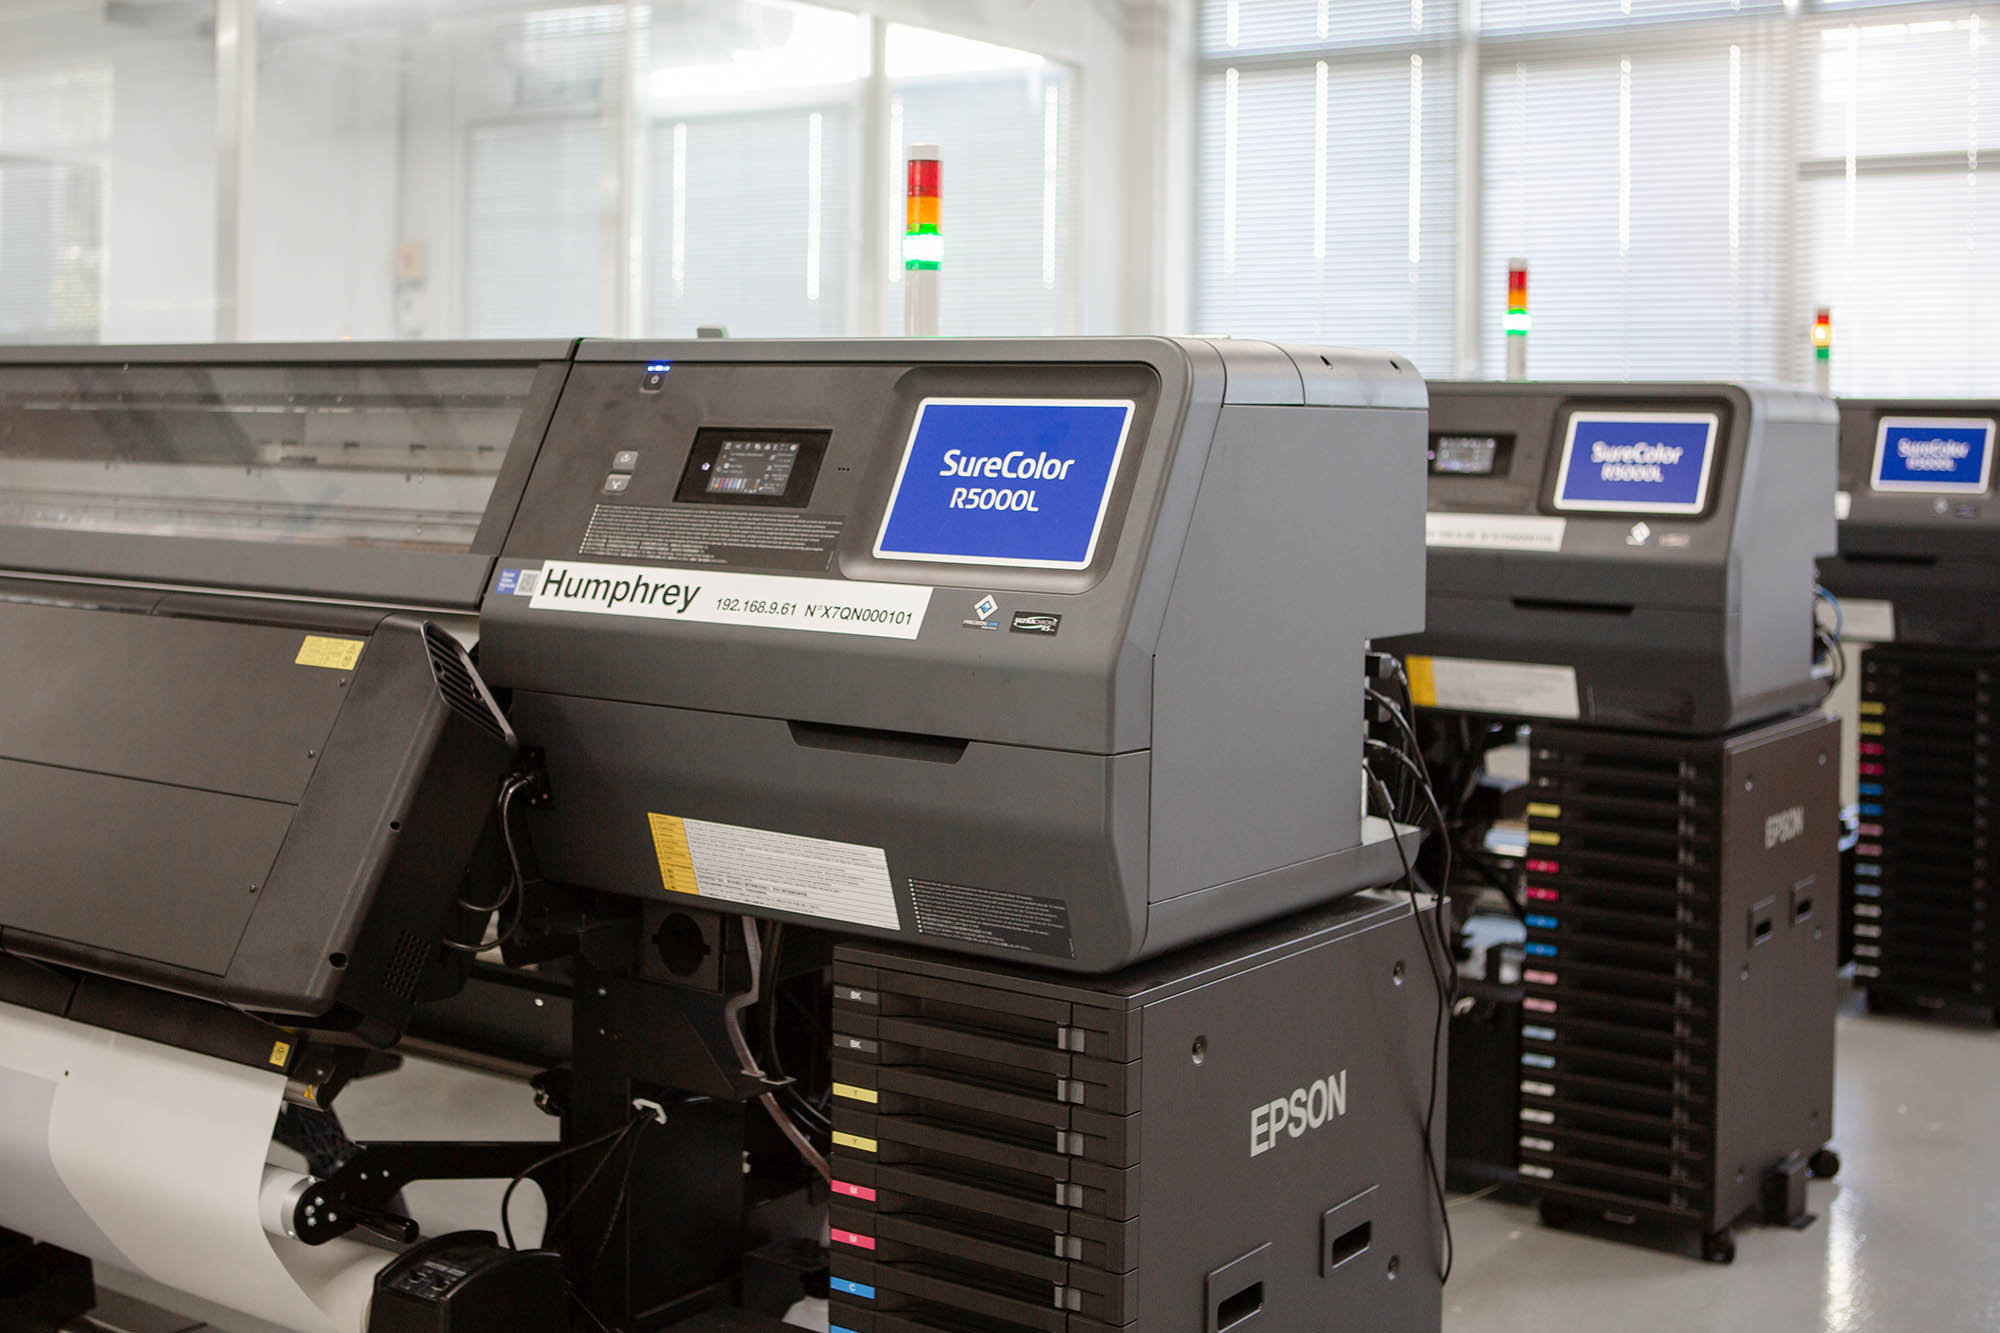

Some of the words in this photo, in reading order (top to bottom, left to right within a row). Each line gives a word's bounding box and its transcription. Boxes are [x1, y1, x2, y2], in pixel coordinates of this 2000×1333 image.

[939, 449, 1076, 480] SureColor
[1591, 441, 1683, 464] SureColor
[949, 487, 1039, 512] R5000L
[540, 568, 702, 614] Humphrey
[716, 598, 798, 617] 192.168.9.61
[1764, 808, 1805, 849] EPSON
[1250, 1069, 1347, 1158] EPSON
